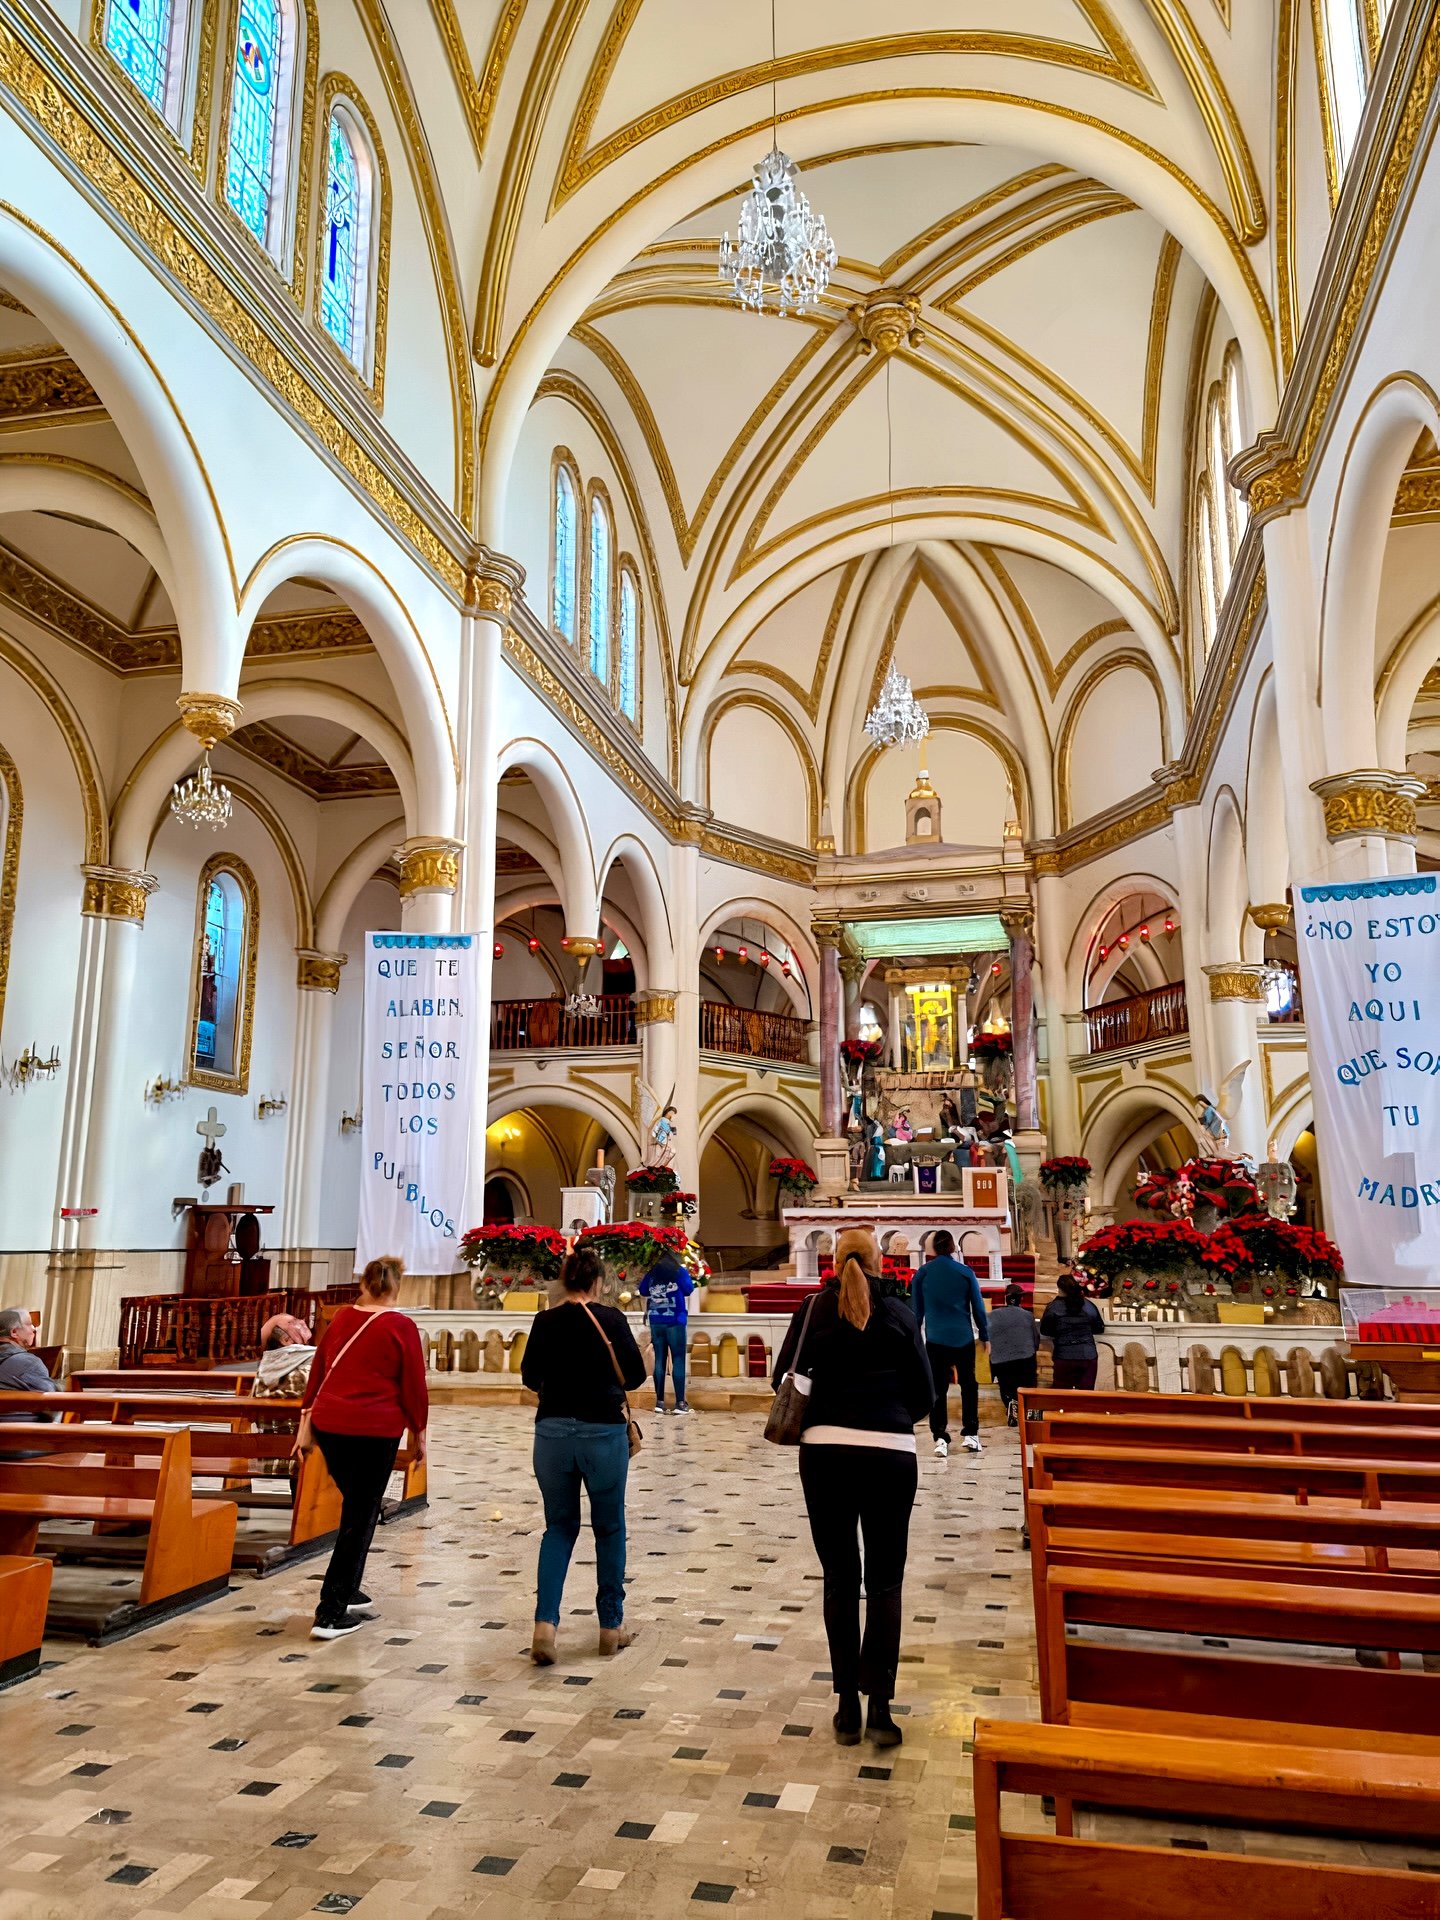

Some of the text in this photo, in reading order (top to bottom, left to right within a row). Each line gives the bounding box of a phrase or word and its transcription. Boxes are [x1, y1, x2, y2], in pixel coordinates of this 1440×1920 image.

[1305, 915, 1353, 940] ¿NO
[378, 959, 459, 979] QUE TE
[1364, 962, 1402, 984] YO
[1348, 998, 1421, 1022] AQUI
[381, 1035, 460, 1060] SEÑOR
[1337, 1049, 1388, 1086] QUE
[381, 1082, 456, 1103] TODOS
[399, 1115, 439, 1136] LOS
[1383, 1105, 1420, 1127] TU
[374, 1151, 458, 1240] PUEBLOS
[1357, 1176, 1440, 1209] MADR
